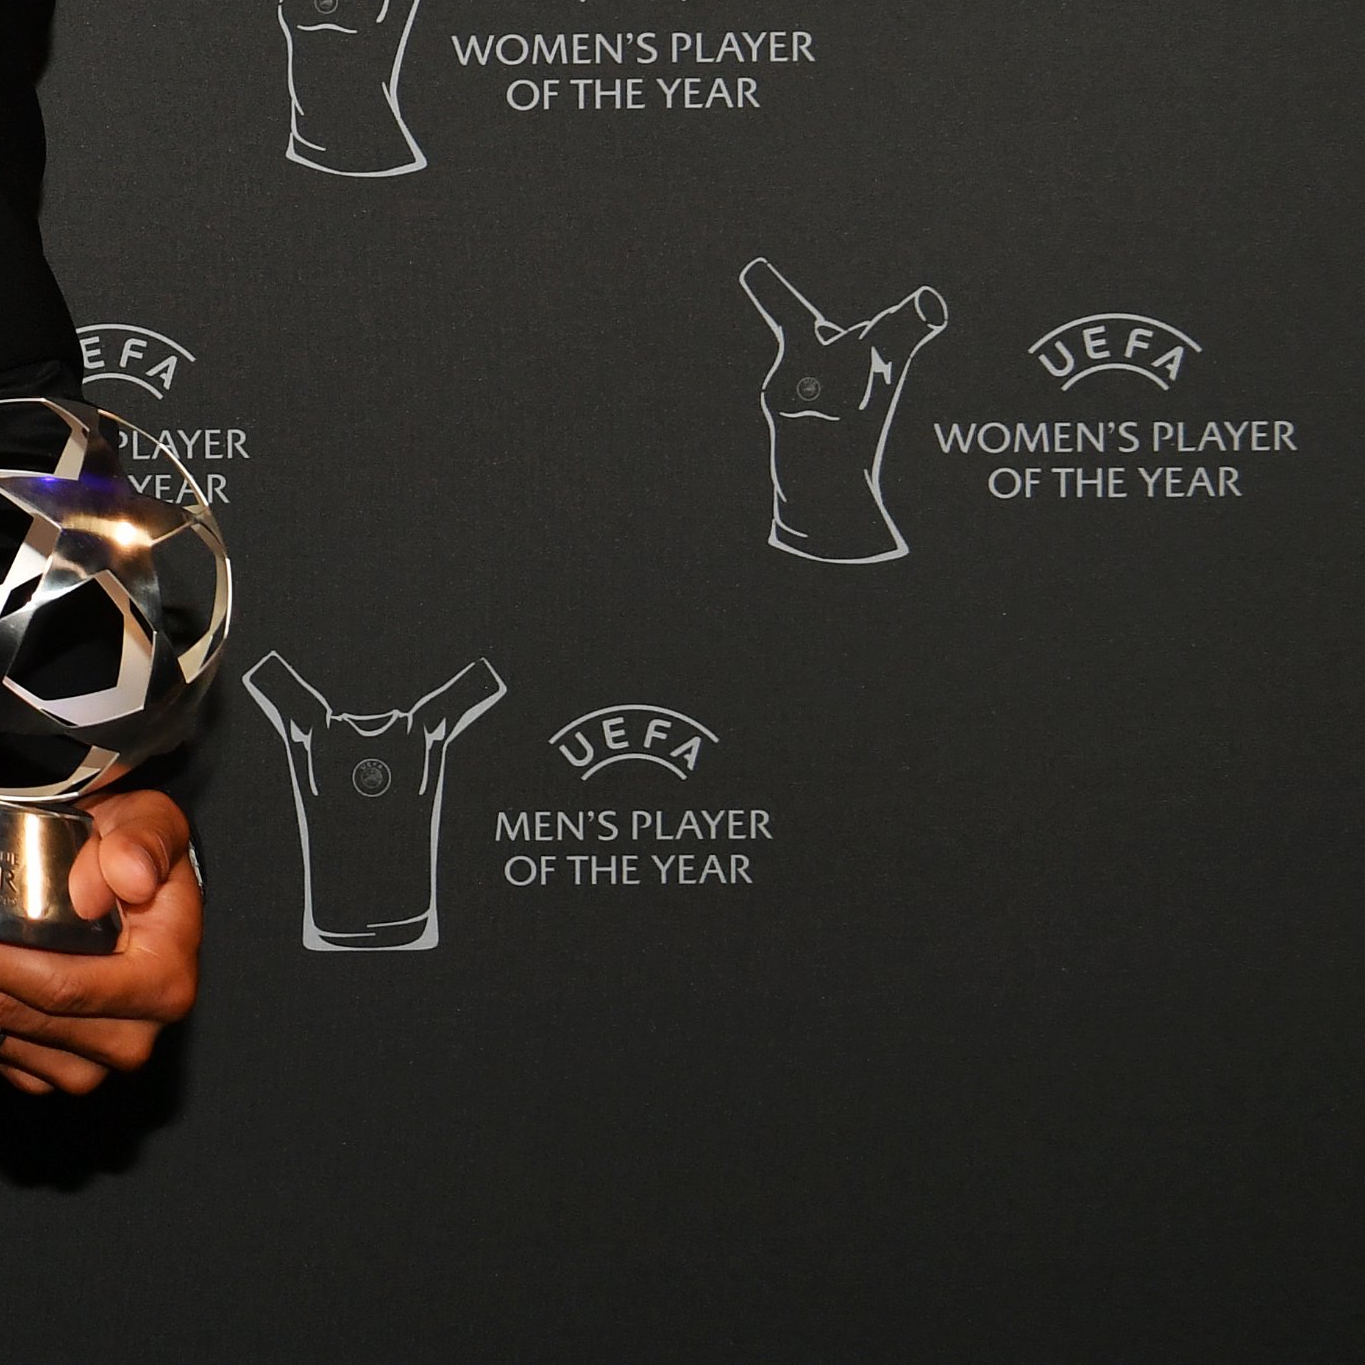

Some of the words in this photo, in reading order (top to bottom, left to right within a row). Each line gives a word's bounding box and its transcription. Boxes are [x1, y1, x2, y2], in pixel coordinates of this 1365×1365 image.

[452, 33, 657, 65] WOMEN'S
[672, 32, 815, 62] PLAYER
[507, 80, 559, 110] OF
[570, 79, 645, 109] THE
[657, 78, 760, 108] YEAR
[80, 336, 177, 391] EFA
[1039, 326, 1184, 380] UEFA
[934, 422, 1139, 453] WOMEN'S
[1154, 421, 1297, 451] PLAYER
[128, 474, 230, 504] YEAR
[989, 468, 1041, 498] OF
[1051, 468, 1127, 497] THE
[1138, 467, 1241, 497] YEAR
[559, 717, 701, 770] UEFA
[496, 811, 618, 841] MEN'S
[632, 810, 772, 840] PLAYER
[505, 856, 556, 886] OF
[567, 856, 640, 884] THE
[652, 855, 752, 884] YEAR
